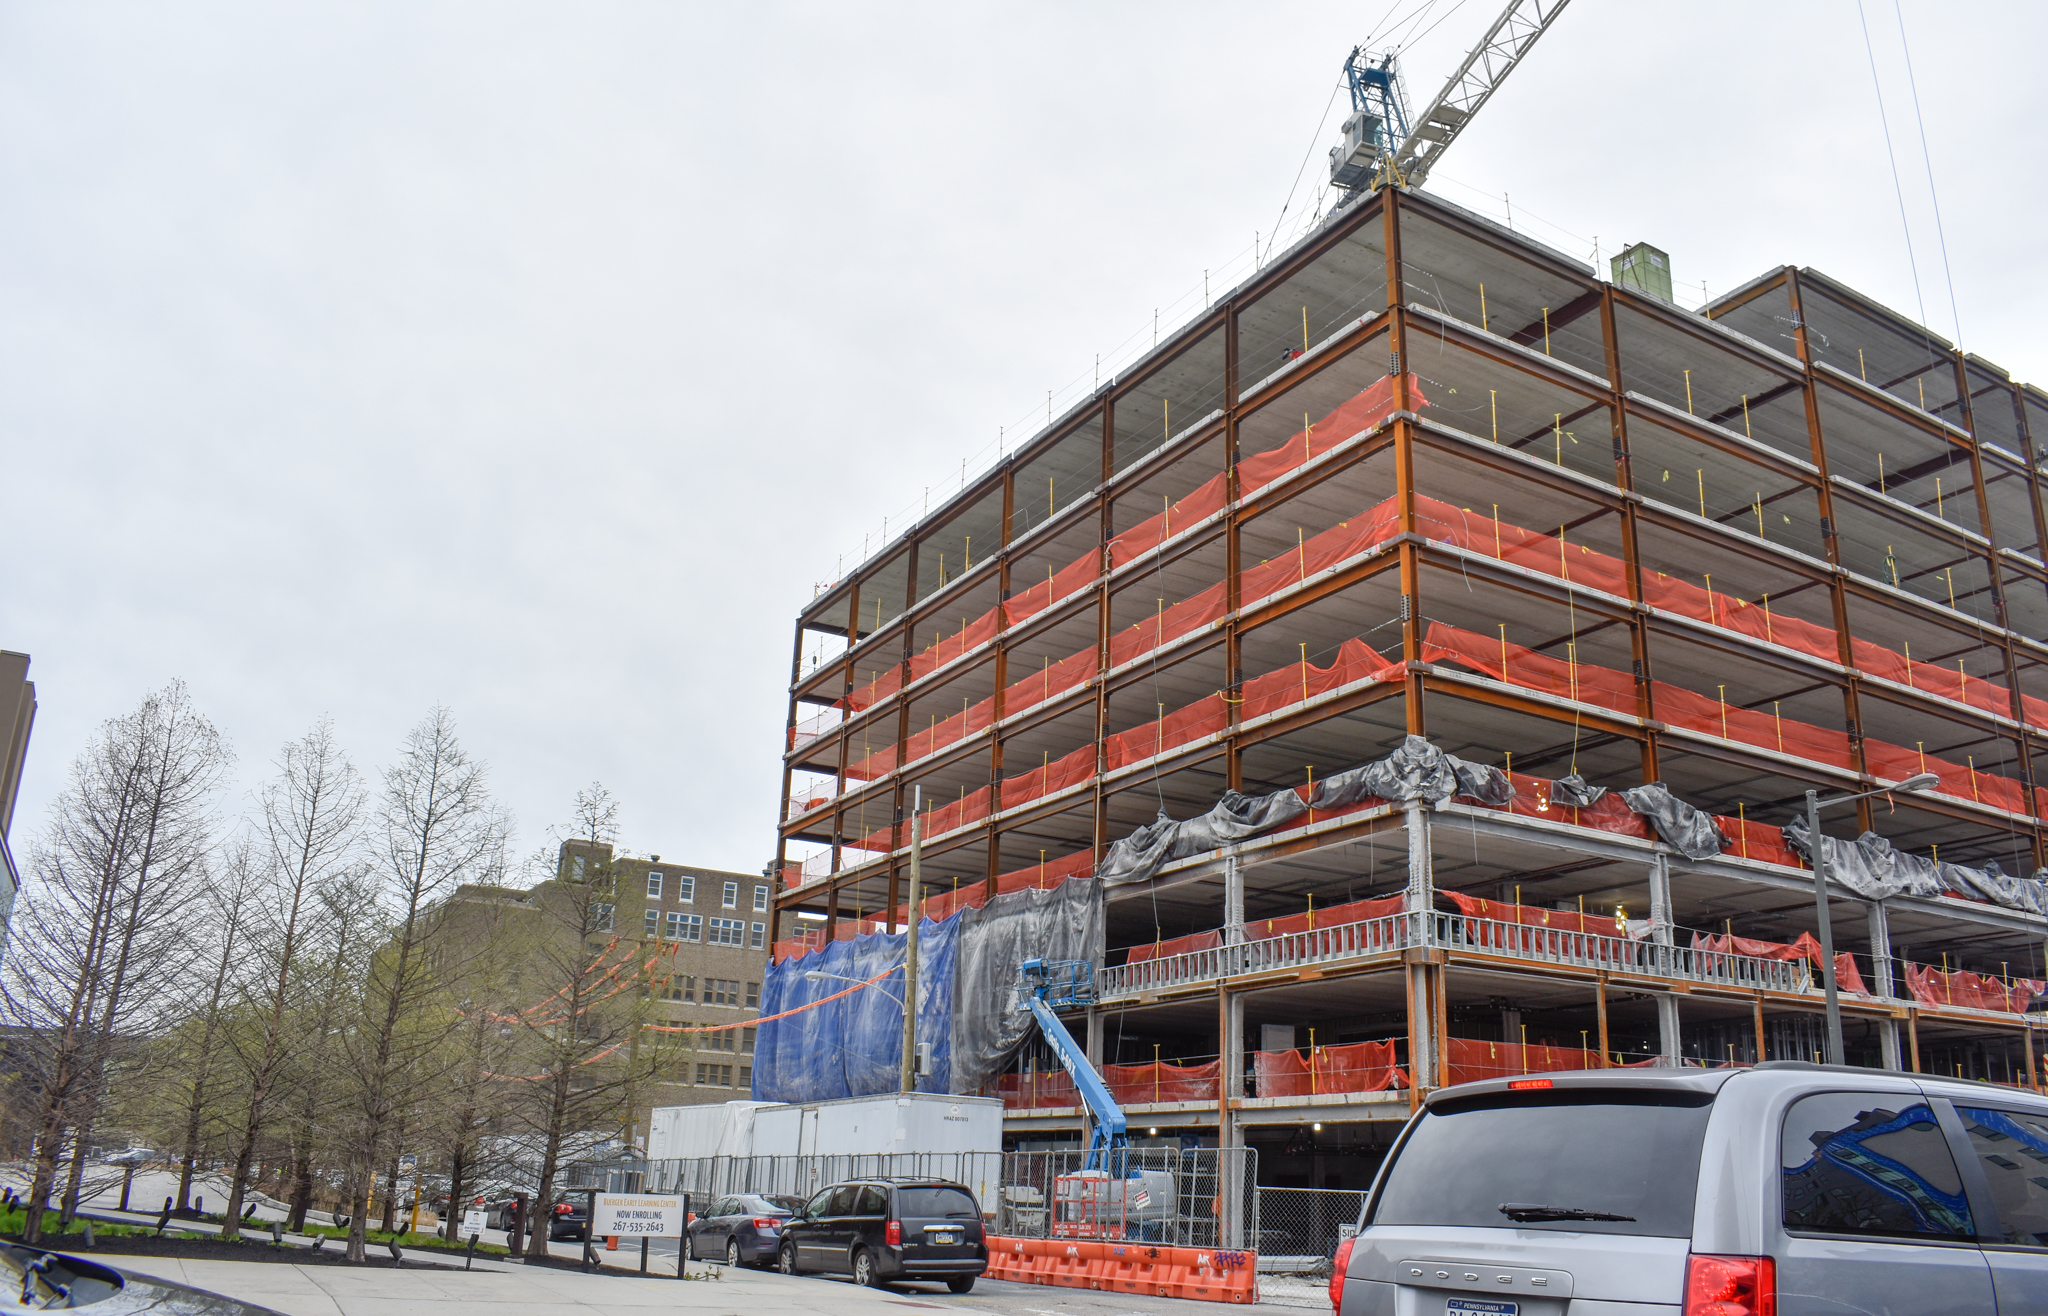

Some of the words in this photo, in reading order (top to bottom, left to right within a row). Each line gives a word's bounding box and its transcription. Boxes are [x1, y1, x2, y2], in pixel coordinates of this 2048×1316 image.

[603, 1198, 623, 1206] BUERGER
[624, 1198, 638, 1207] EARLY
[638, 1199, 659, 1208] LEARNING
[660, 1200, 677, 1208] CENTER
[616, 1210, 631, 1219] NOW
[632, 1210, 662, 1219] ENROLLING
[613, 1221, 664, 1232] 267-535-2643
[1411, 1268, 1548, 1286] DODGE
[1463, 1303, 1500, 1311] PENNSYLVANIA
